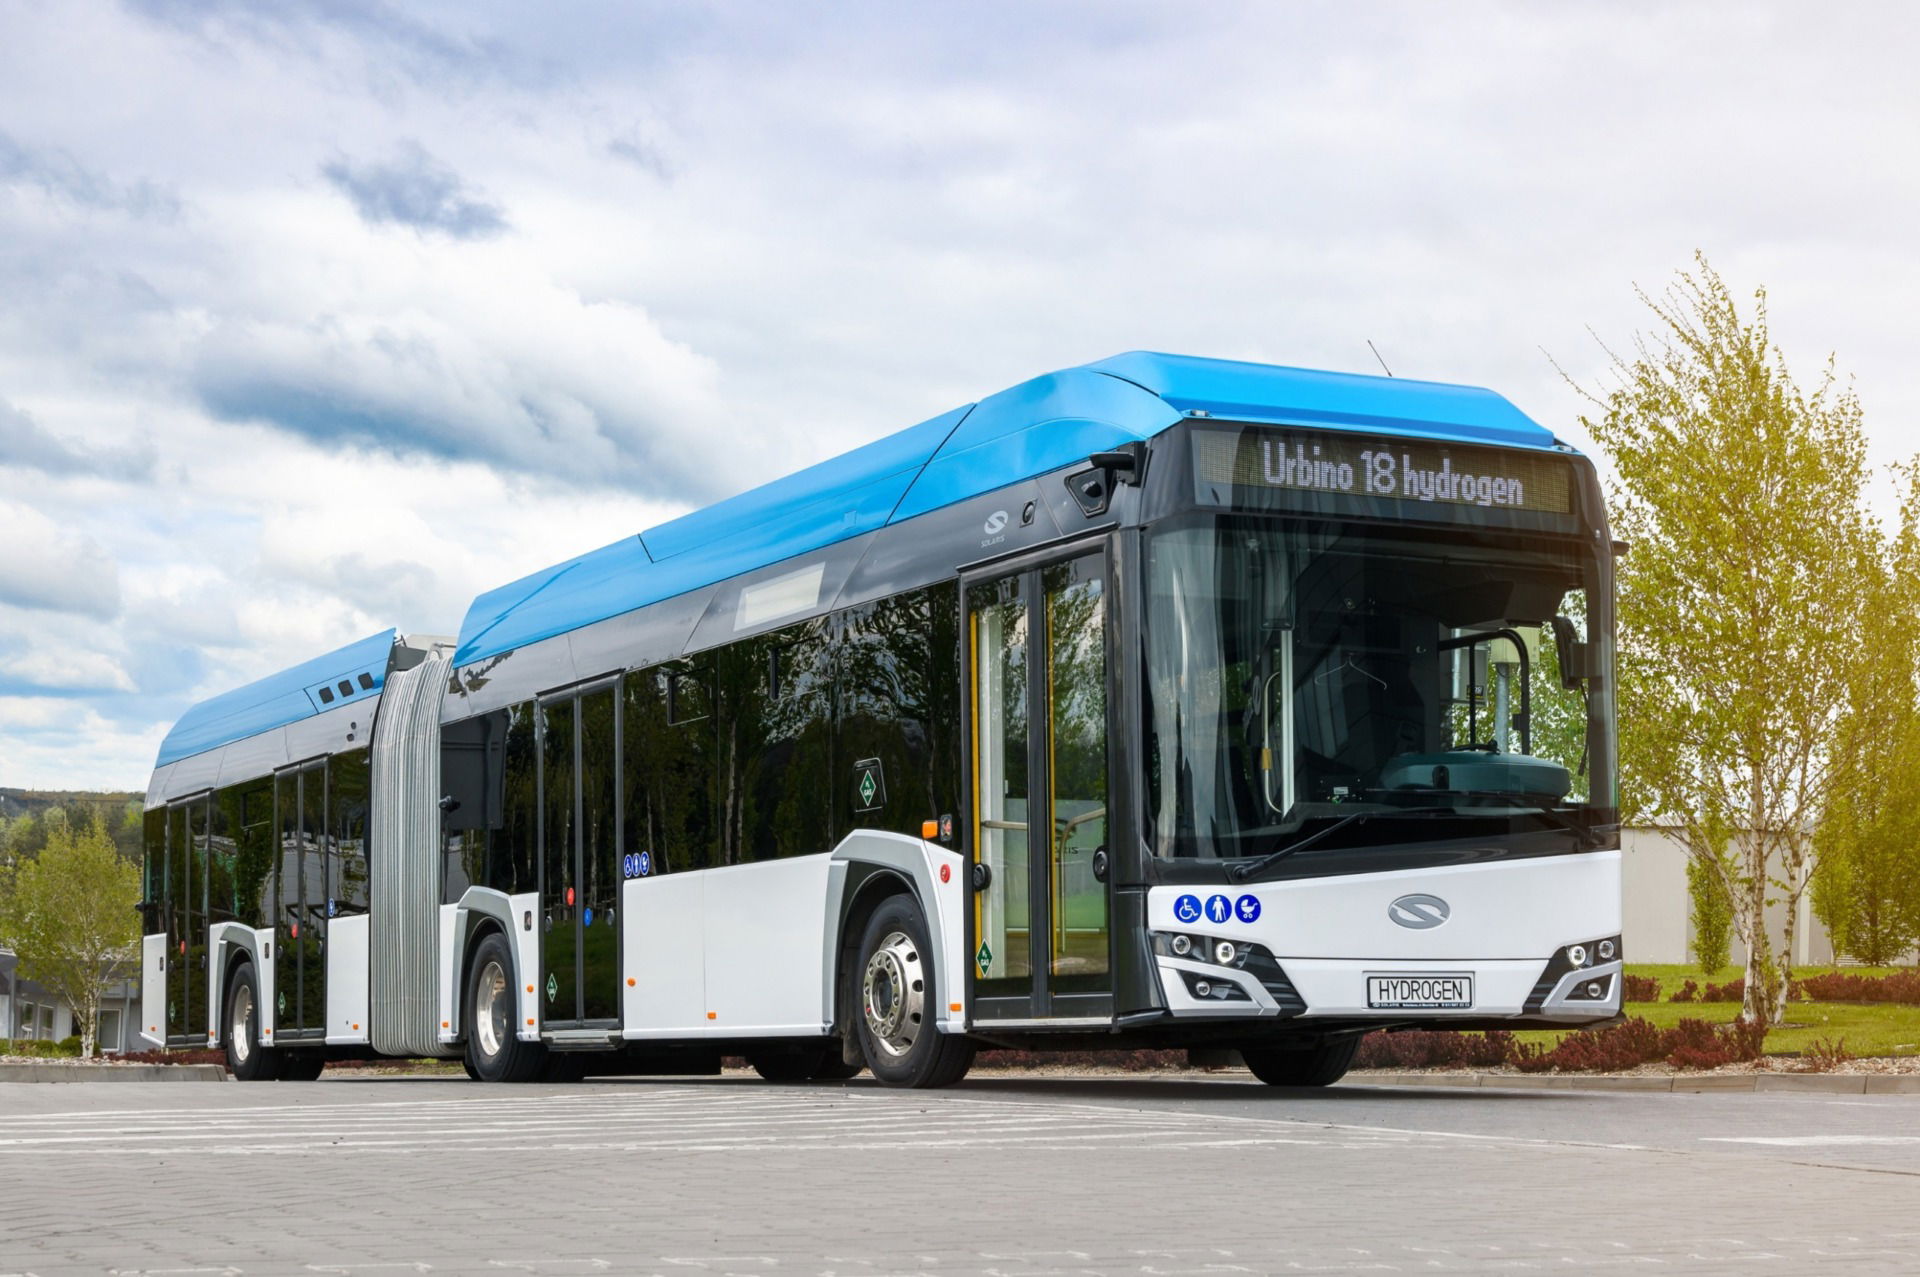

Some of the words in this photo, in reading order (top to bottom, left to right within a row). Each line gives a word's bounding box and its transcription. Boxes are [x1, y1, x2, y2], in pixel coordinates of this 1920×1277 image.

[1263, 440, 1353, 490] Urbino
[1360, 450, 1396, 494] 18
[1402, 455, 1523, 506] hydrogen
[1379, 980, 1463, 1000] HYDROGEN
